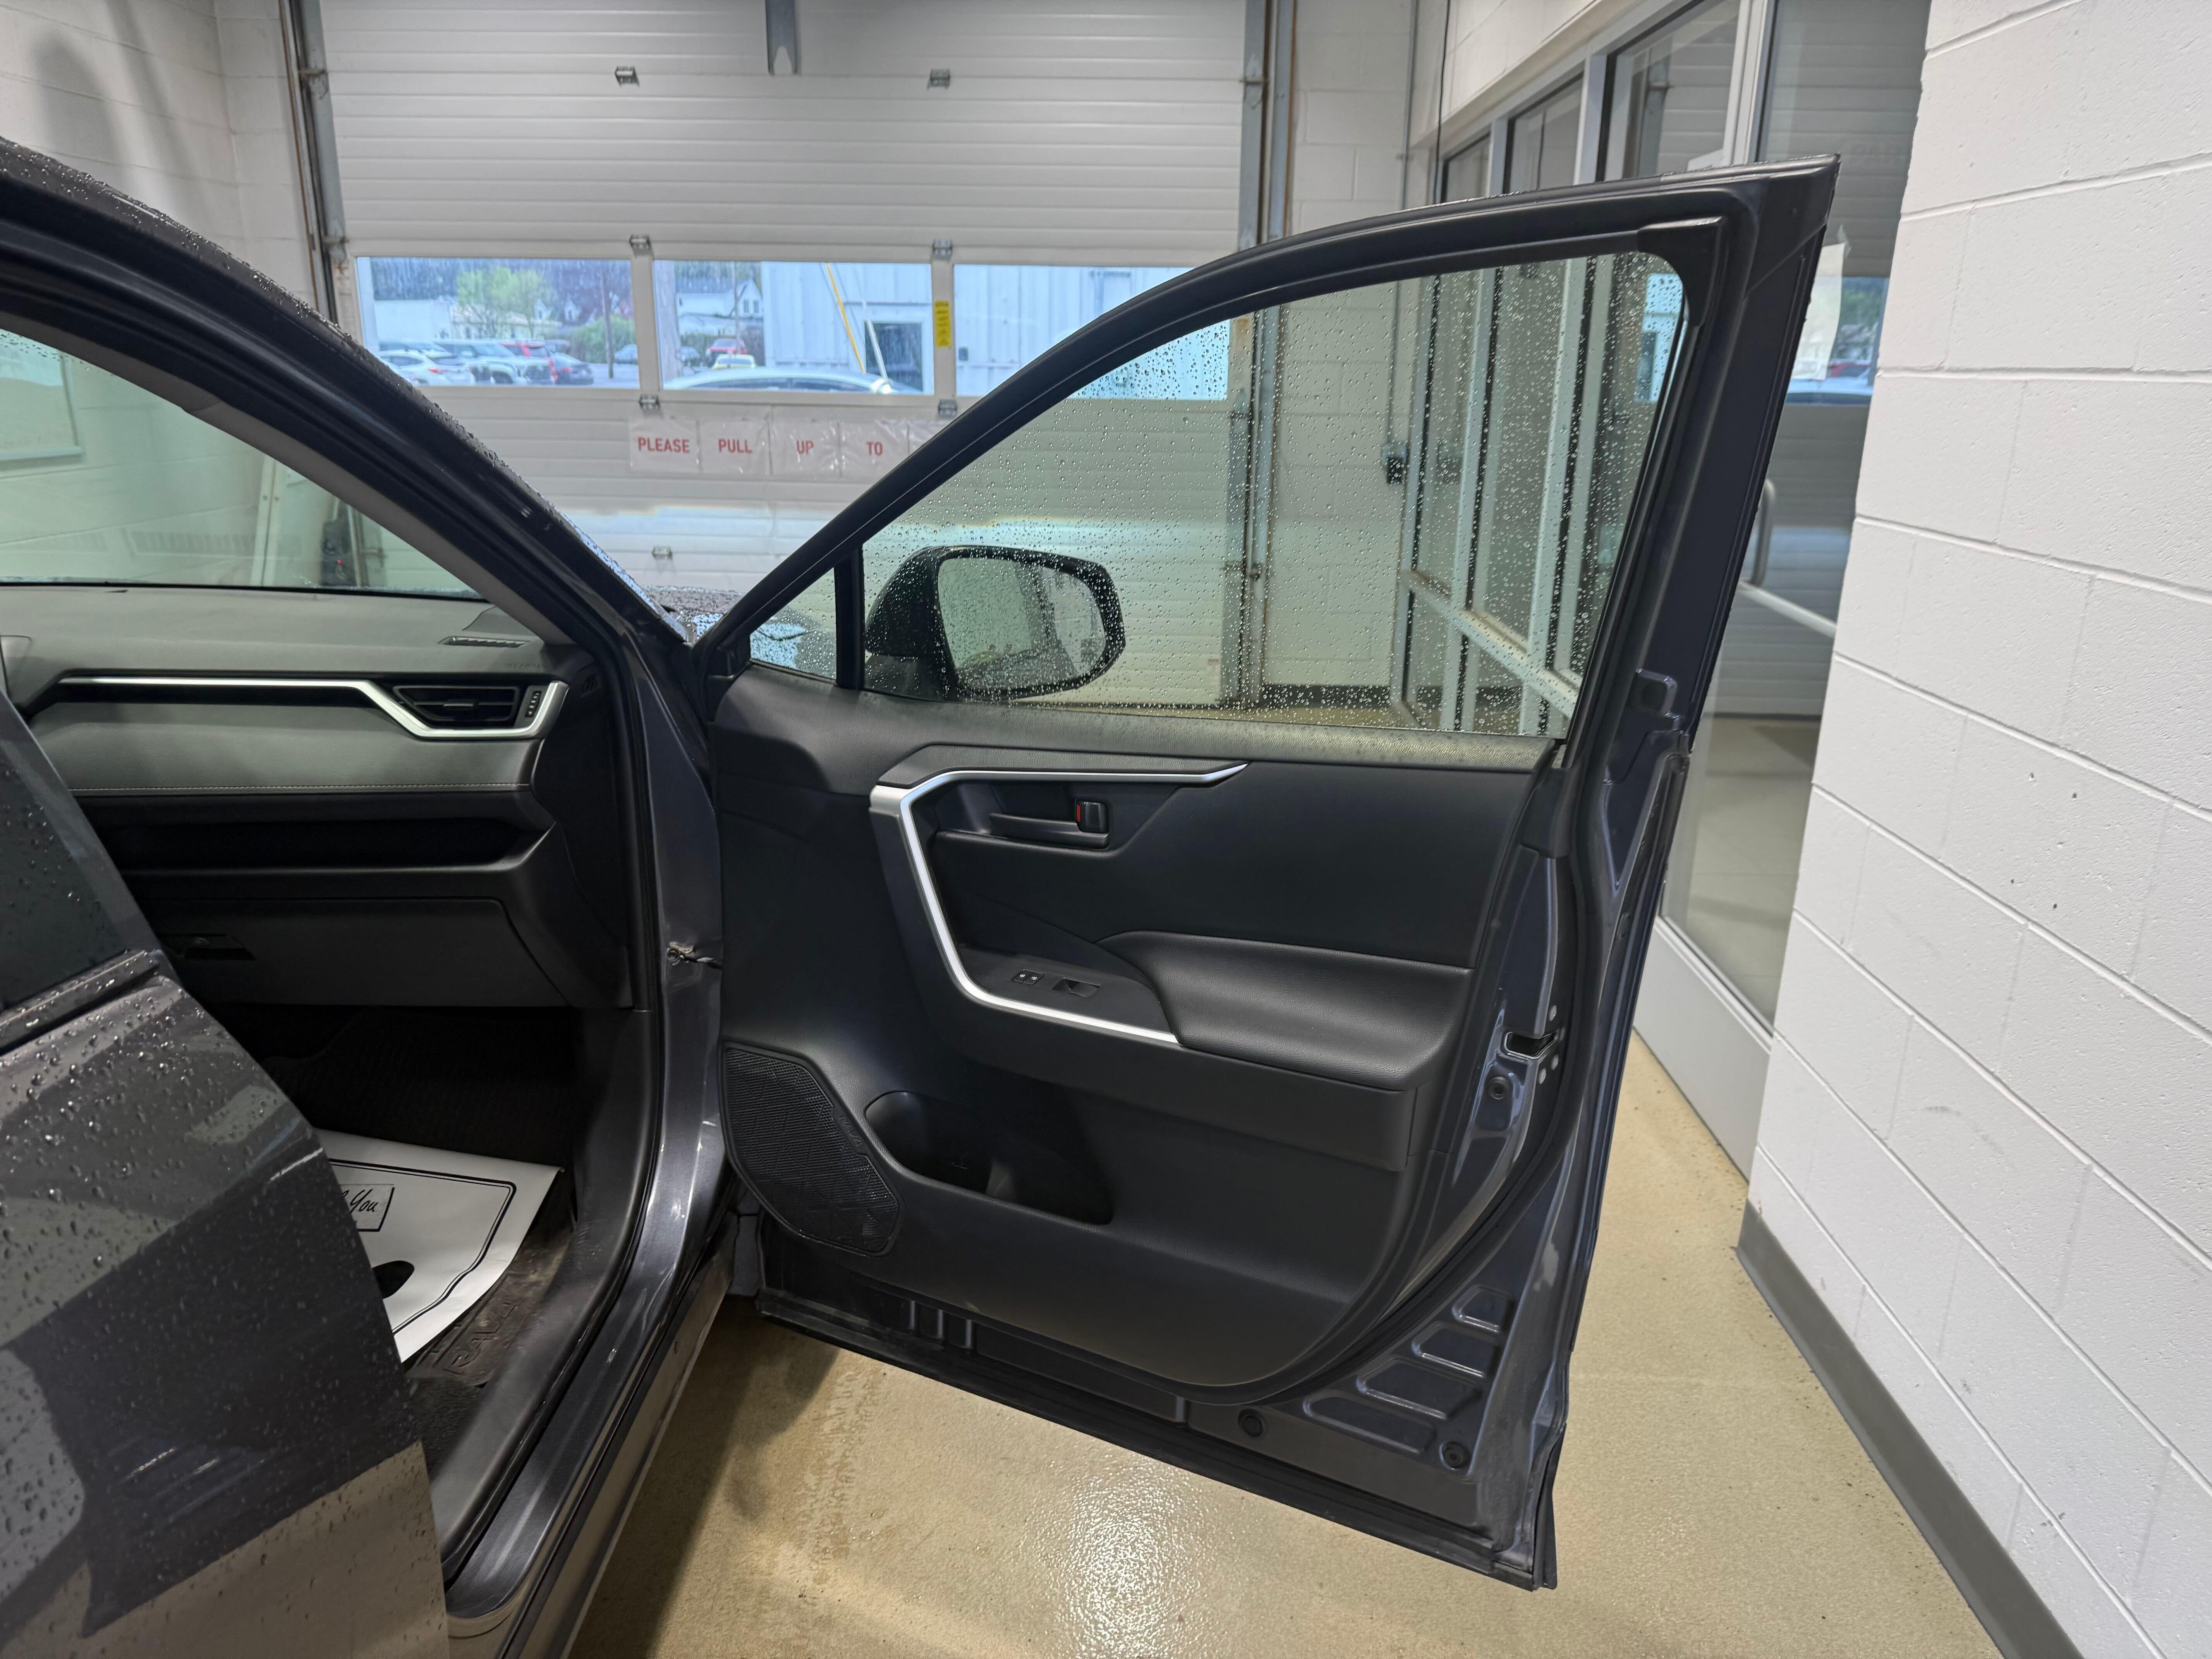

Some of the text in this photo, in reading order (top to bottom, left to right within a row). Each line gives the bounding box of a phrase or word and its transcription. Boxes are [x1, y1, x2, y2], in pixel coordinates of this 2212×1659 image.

[638, 436, 883, 456] PLEASE PULL UP TO
[350, 1188, 378, 1213] You
